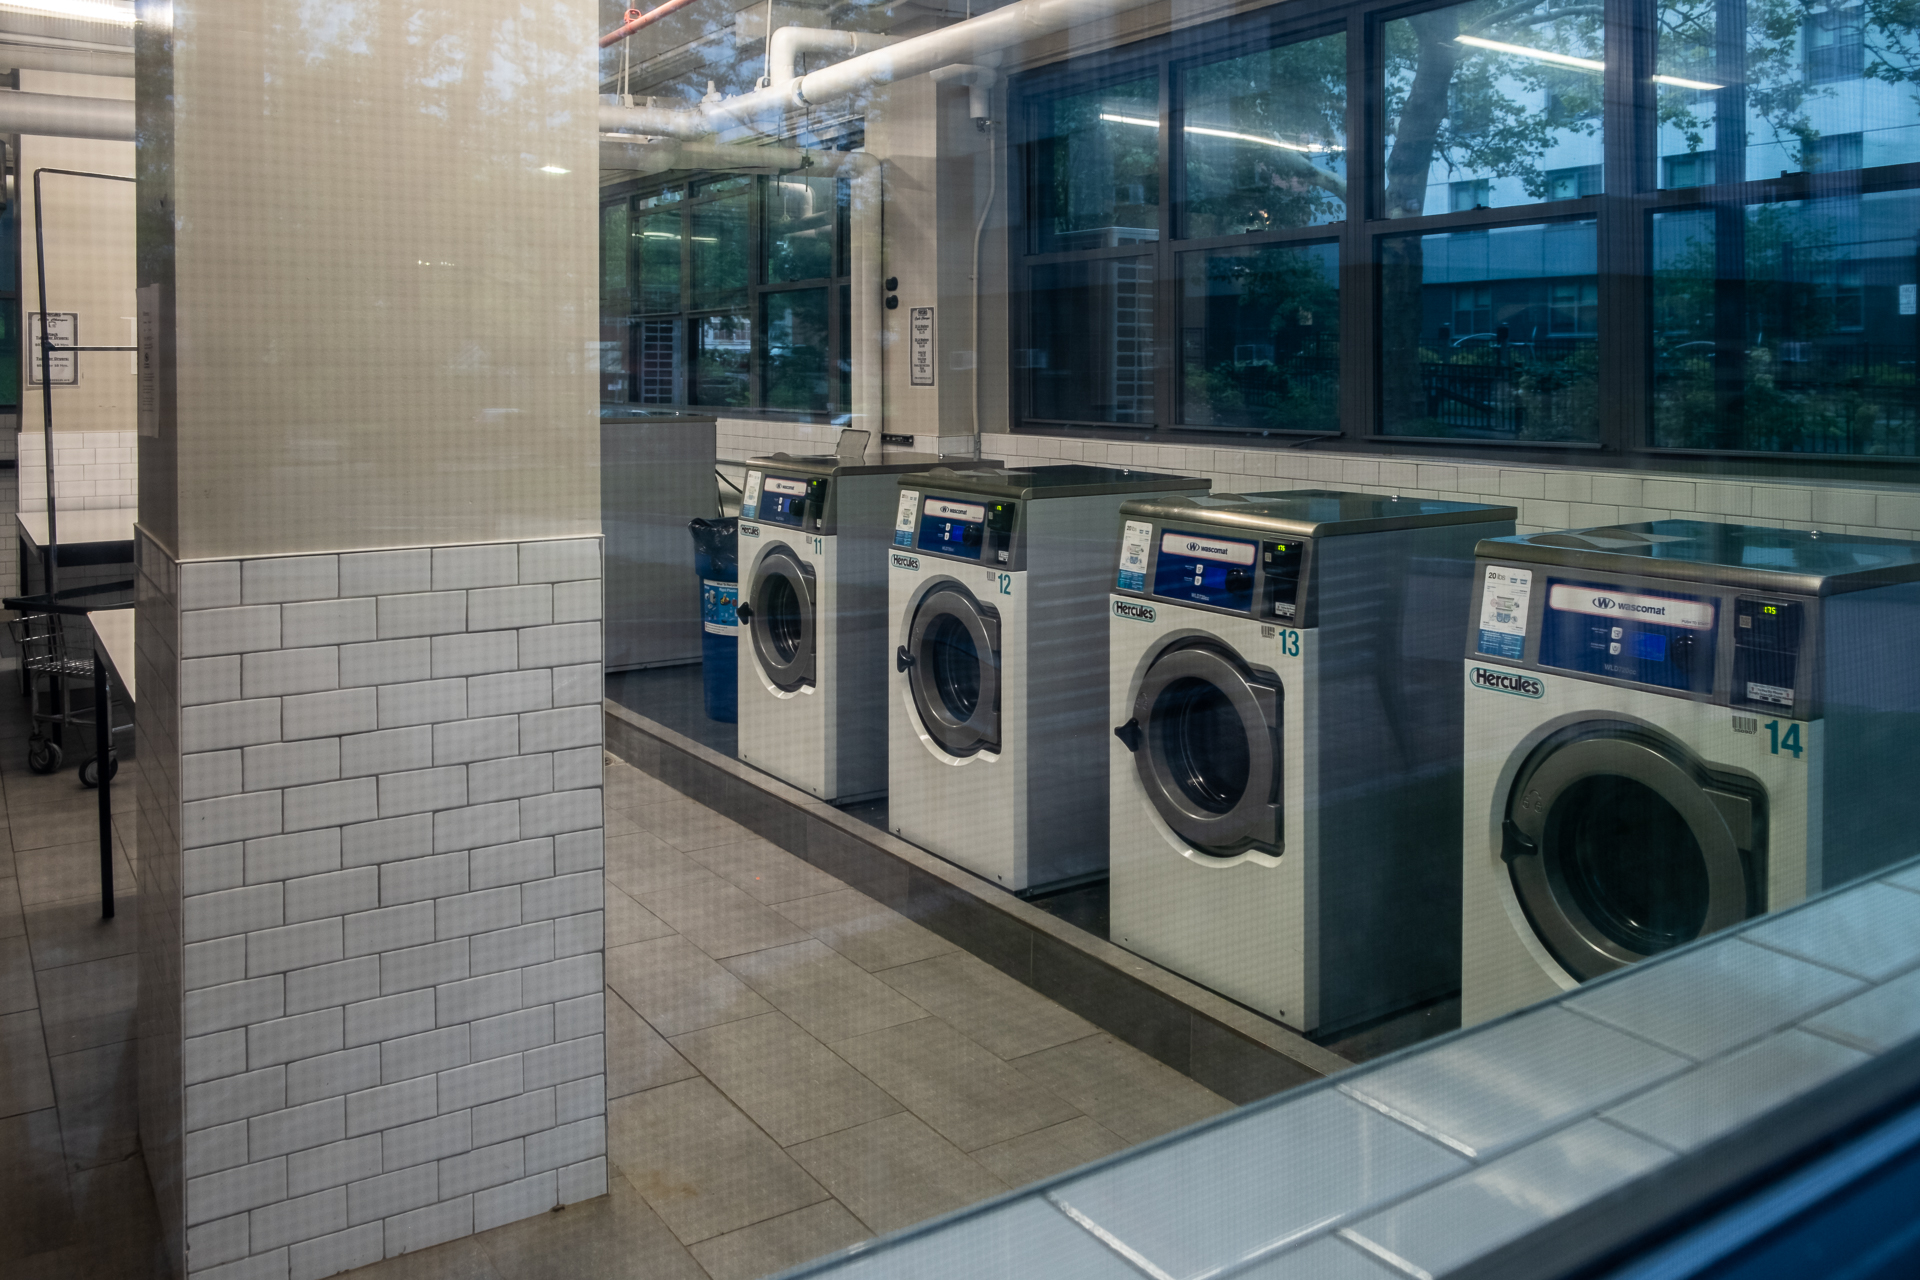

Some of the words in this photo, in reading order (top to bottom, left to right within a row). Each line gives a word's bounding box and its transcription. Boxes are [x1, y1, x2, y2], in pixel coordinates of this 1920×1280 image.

[814, 537, 822, 555] 11
[1201, 545, 1228, 555] wascomat
[893, 554, 919, 569] Hercules
[998, 573, 1011, 595] 12
[1488, 572, 1497, 580] 20
[1497, 573, 1506, 581] lbs
[1115, 601, 1154, 620] Hercules
[1618, 602, 1666, 616] wascomat
[1279, 629, 1300, 657] 13
[1476, 668, 1540, 695] Hercules
[1764, 720, 1803, 759] 14
